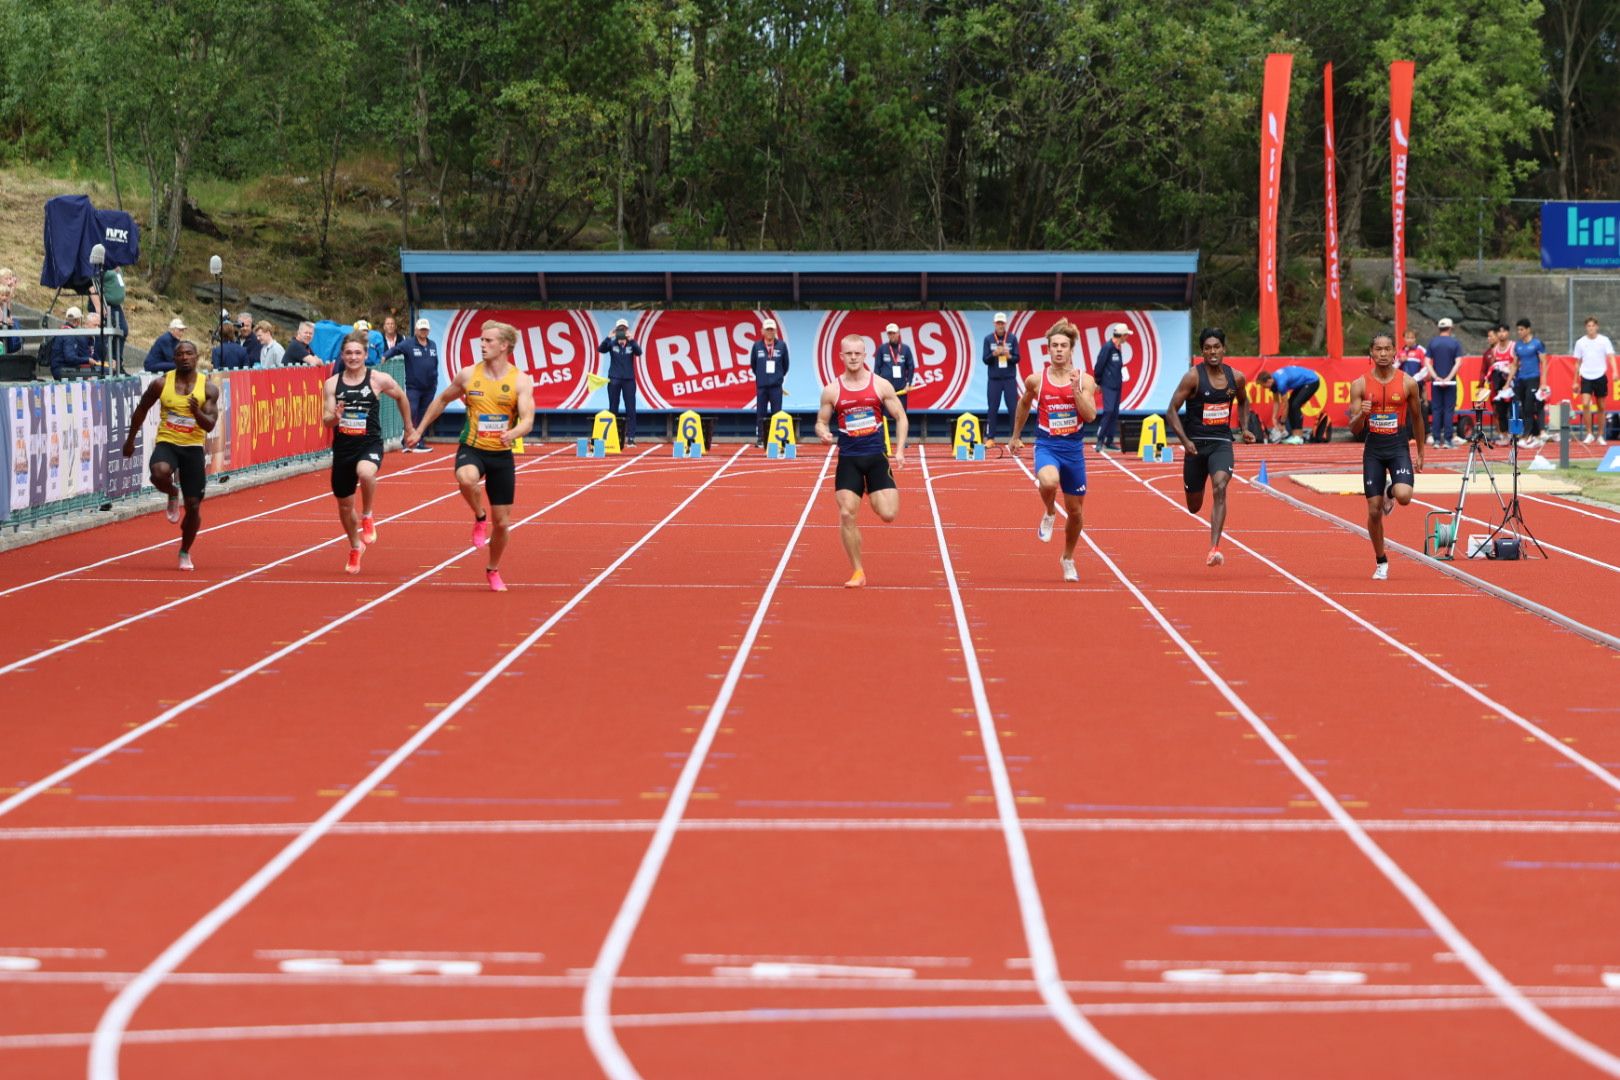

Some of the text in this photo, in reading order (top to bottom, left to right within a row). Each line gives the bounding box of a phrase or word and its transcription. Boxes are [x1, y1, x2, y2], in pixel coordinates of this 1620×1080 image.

[655, 322, 757, 382] RIIS
[672, 369, 757, 397] BILGLASS
[599, 417, 613, 441] 7
[682, 417, 697, 440] 6
[774, 417, 789, 441] 5
[960, 419, 976, 443] 3
[1051, 418, 1077, 428] HOLMEN
[1147, 422, 1158, 444] 1
